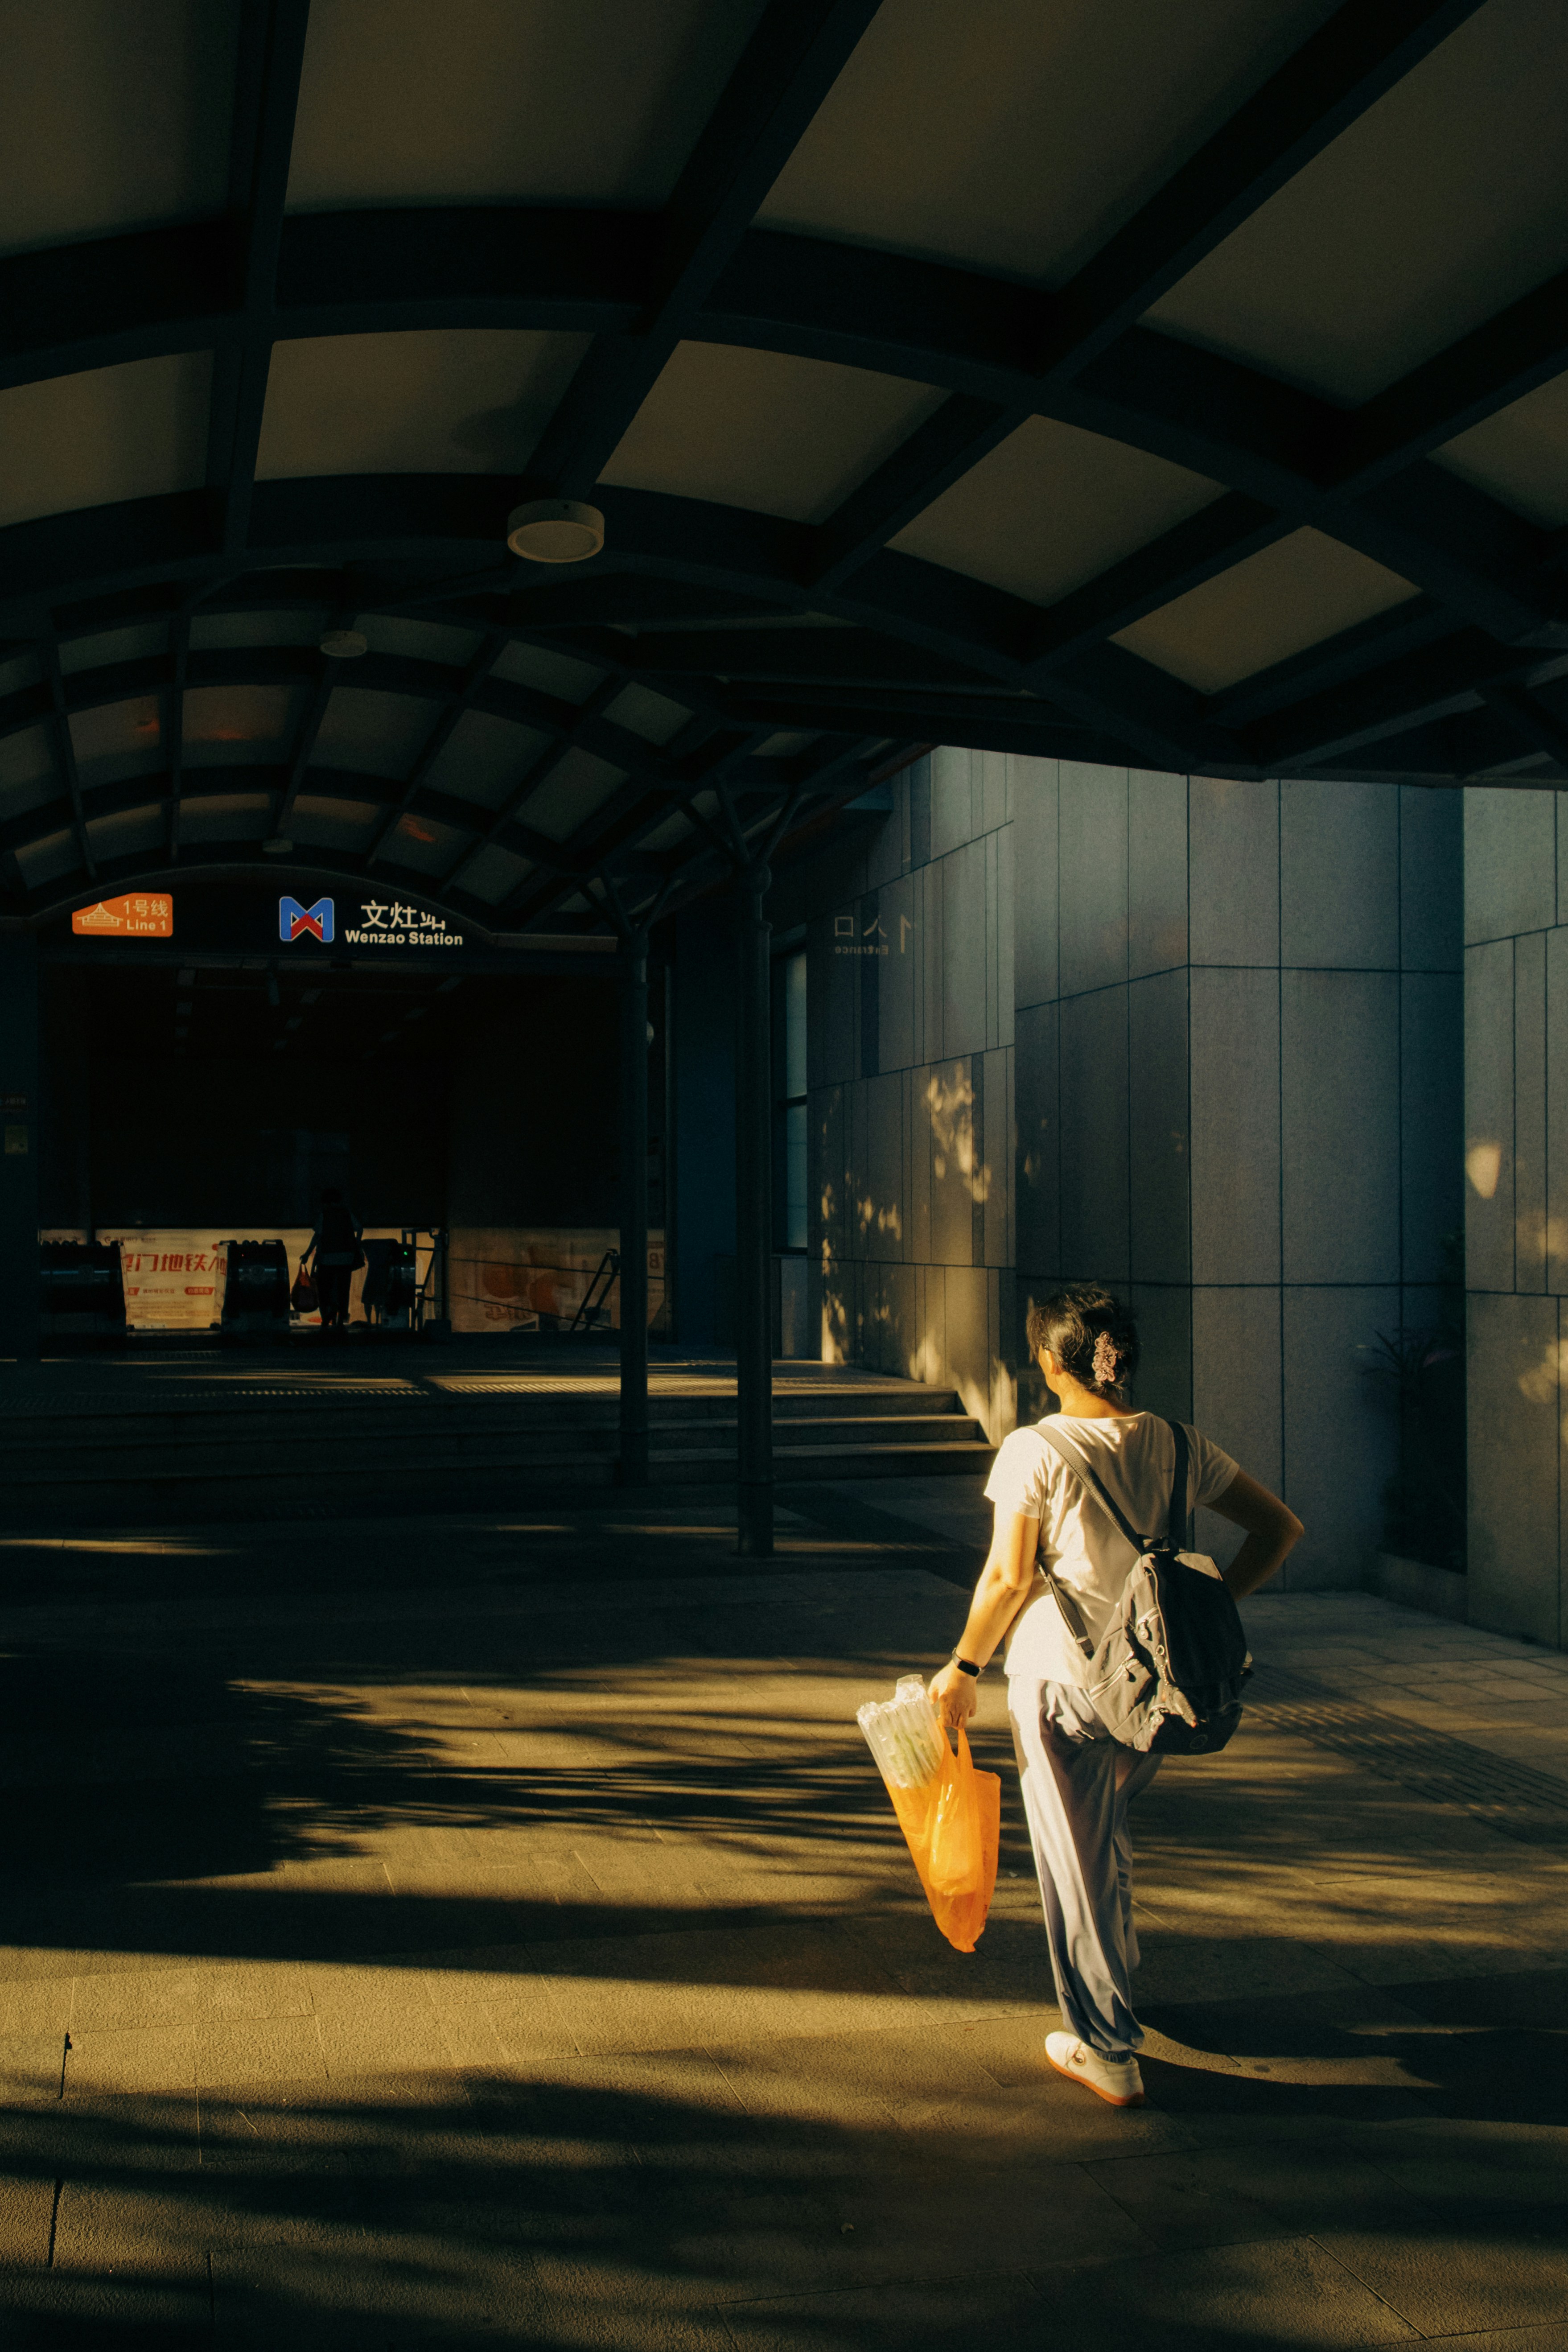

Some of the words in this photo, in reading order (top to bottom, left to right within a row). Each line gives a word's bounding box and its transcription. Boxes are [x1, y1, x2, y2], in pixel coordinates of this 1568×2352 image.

[123, 900, 169, 917] 1号线
[127, 919, 156, 931] Line
[160, 920, 166, 931] 1
[345, 930, 405, 944] Wenzao
[409, 931, 463, 945] Station
